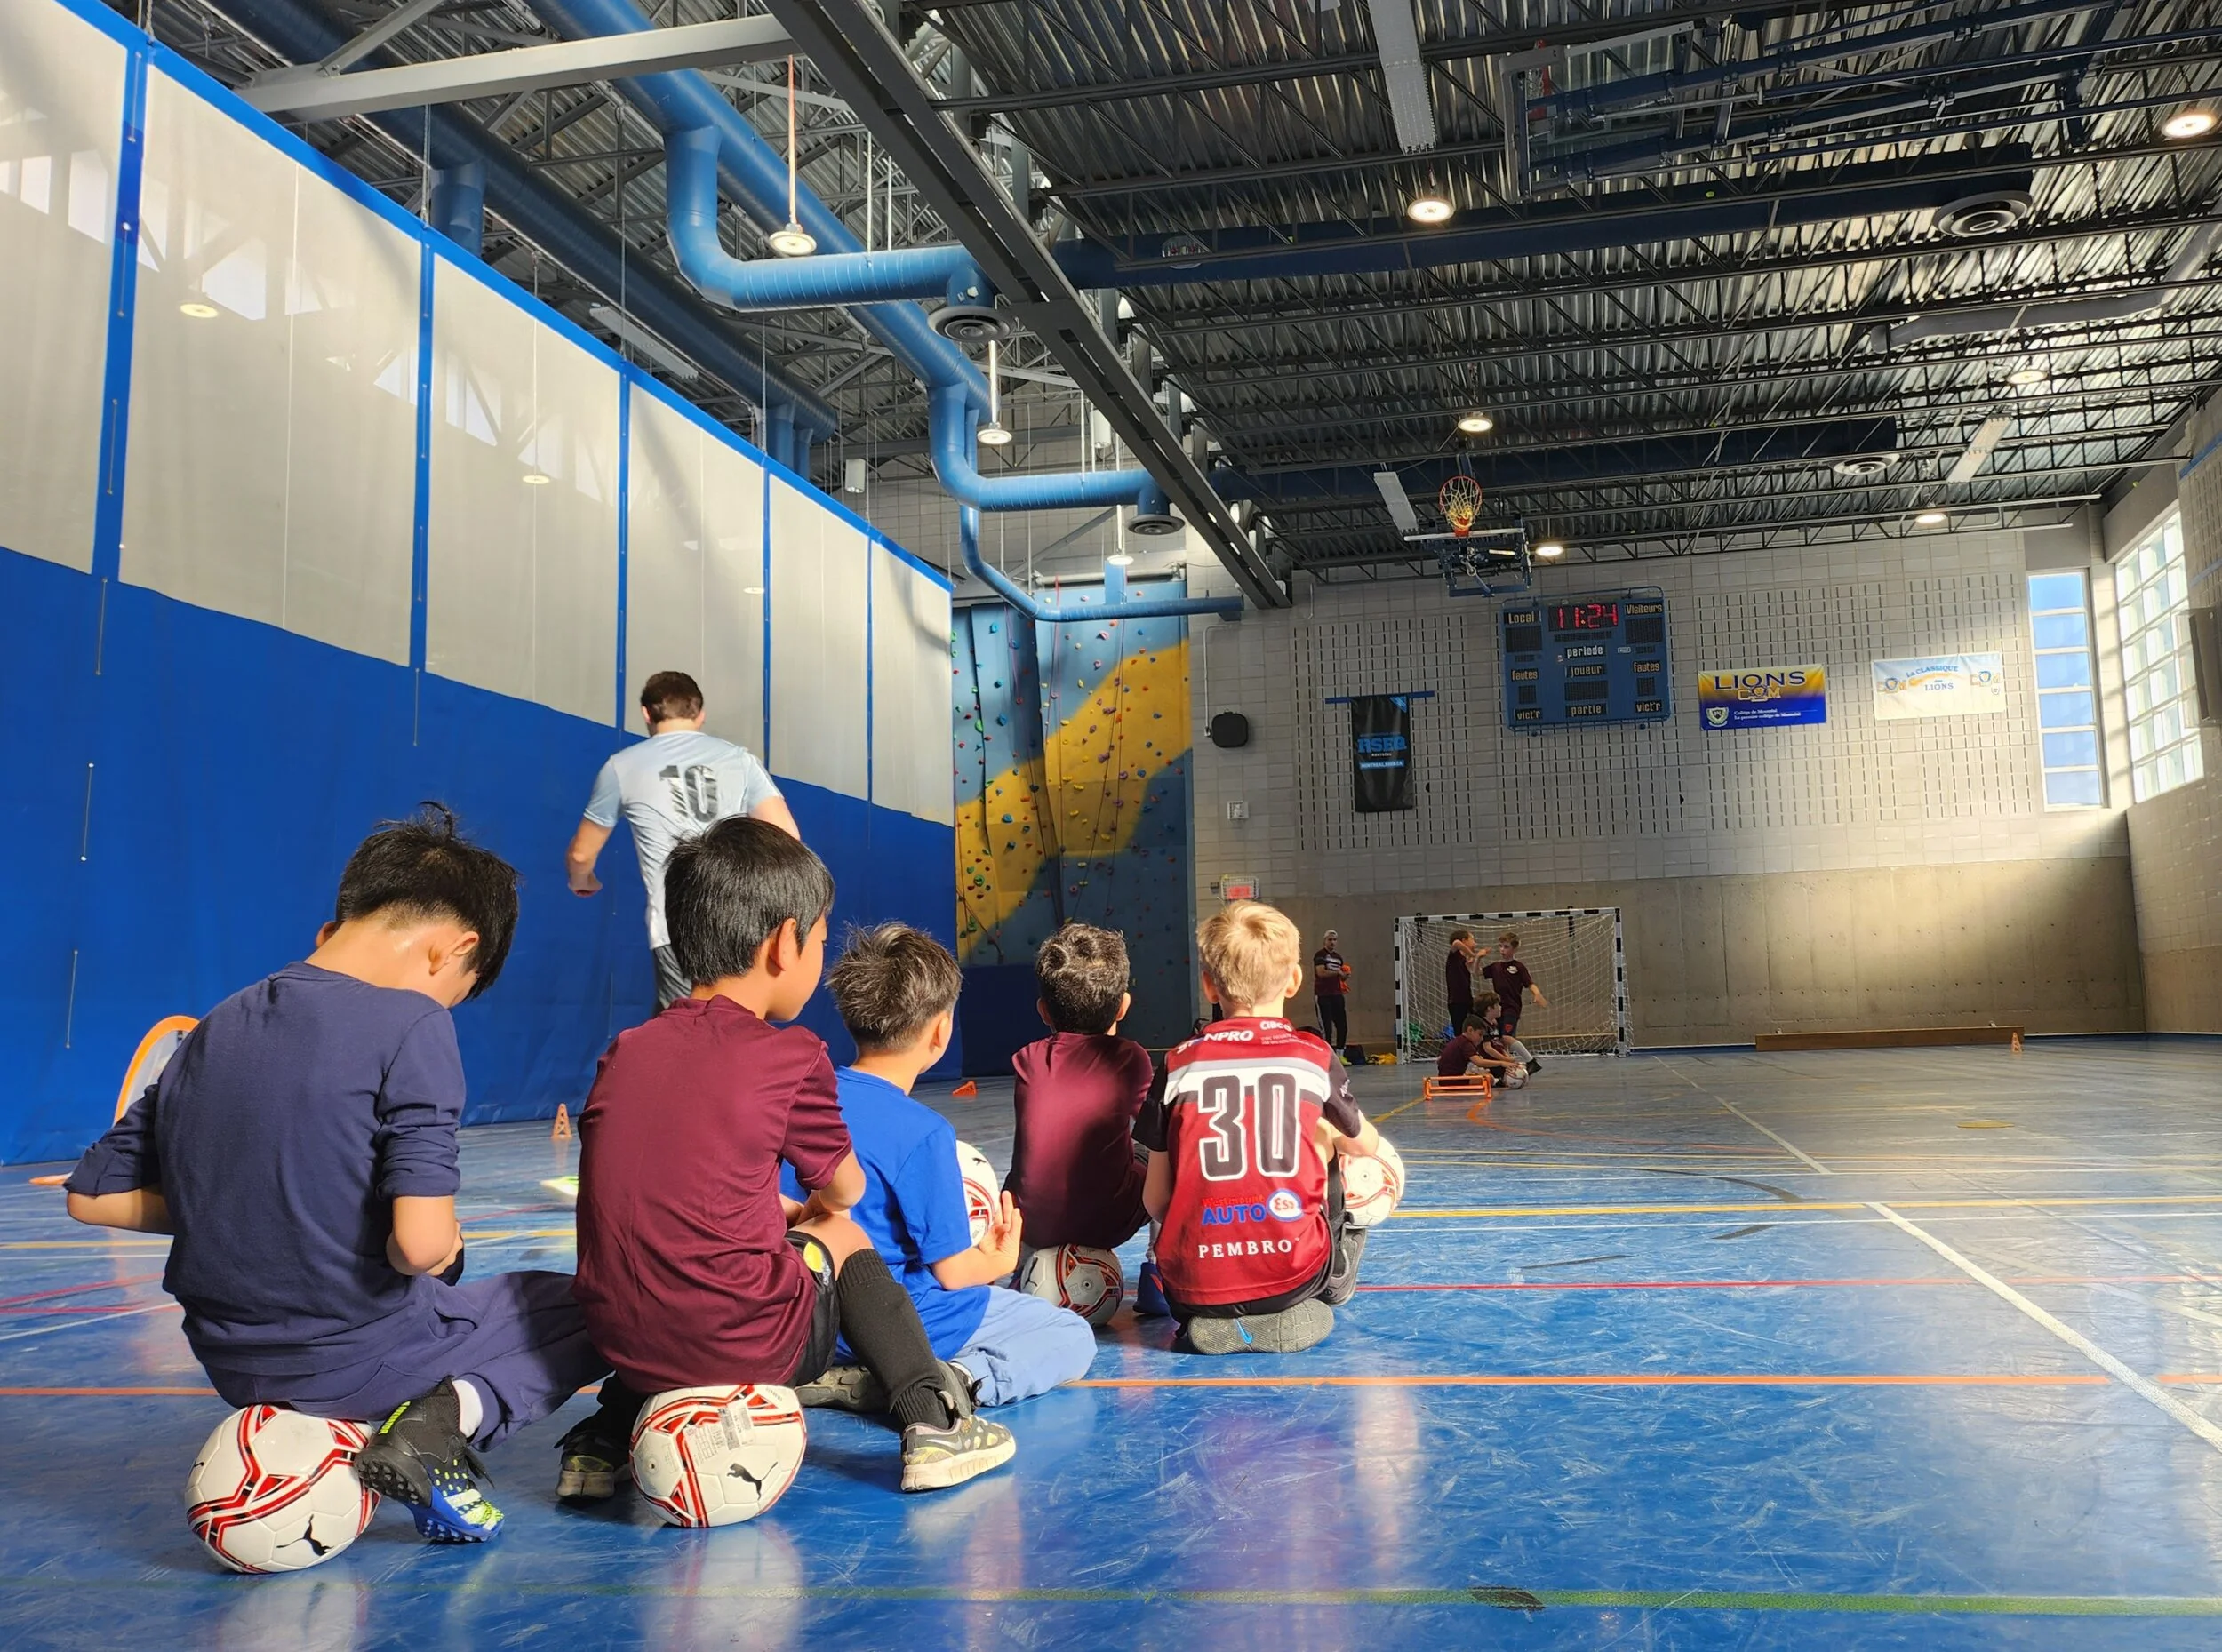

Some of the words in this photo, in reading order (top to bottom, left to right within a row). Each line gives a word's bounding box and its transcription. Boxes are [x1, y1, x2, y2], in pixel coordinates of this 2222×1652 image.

[1626, 603, 1663, 615] Visiteurs
[1508, 611, 1535, 624] Local
[1557, 603, 1619, 629] 11:24
[1571, 666, 1602, 678] joueur
[1633, 661, 1660, 673] fautes
[1915, 665, 1959, 675] CLASSIQUE
[1511, 670, 1538, 681] fautes
[1714, 671, 1806, 690] LIONS
[1924, 682, 1954, 691] LIONS
[1571, 705, 1602, 717] partie
[1357, 736, 1407, 753] RSEQ
[659, 764, 718, 822] 10
[1198, 1073, 1301, 1181] 30
[1202, 1203, 1267, 1225] AUTO
[1198, 1239, 1293, 1258] PEMBRO
